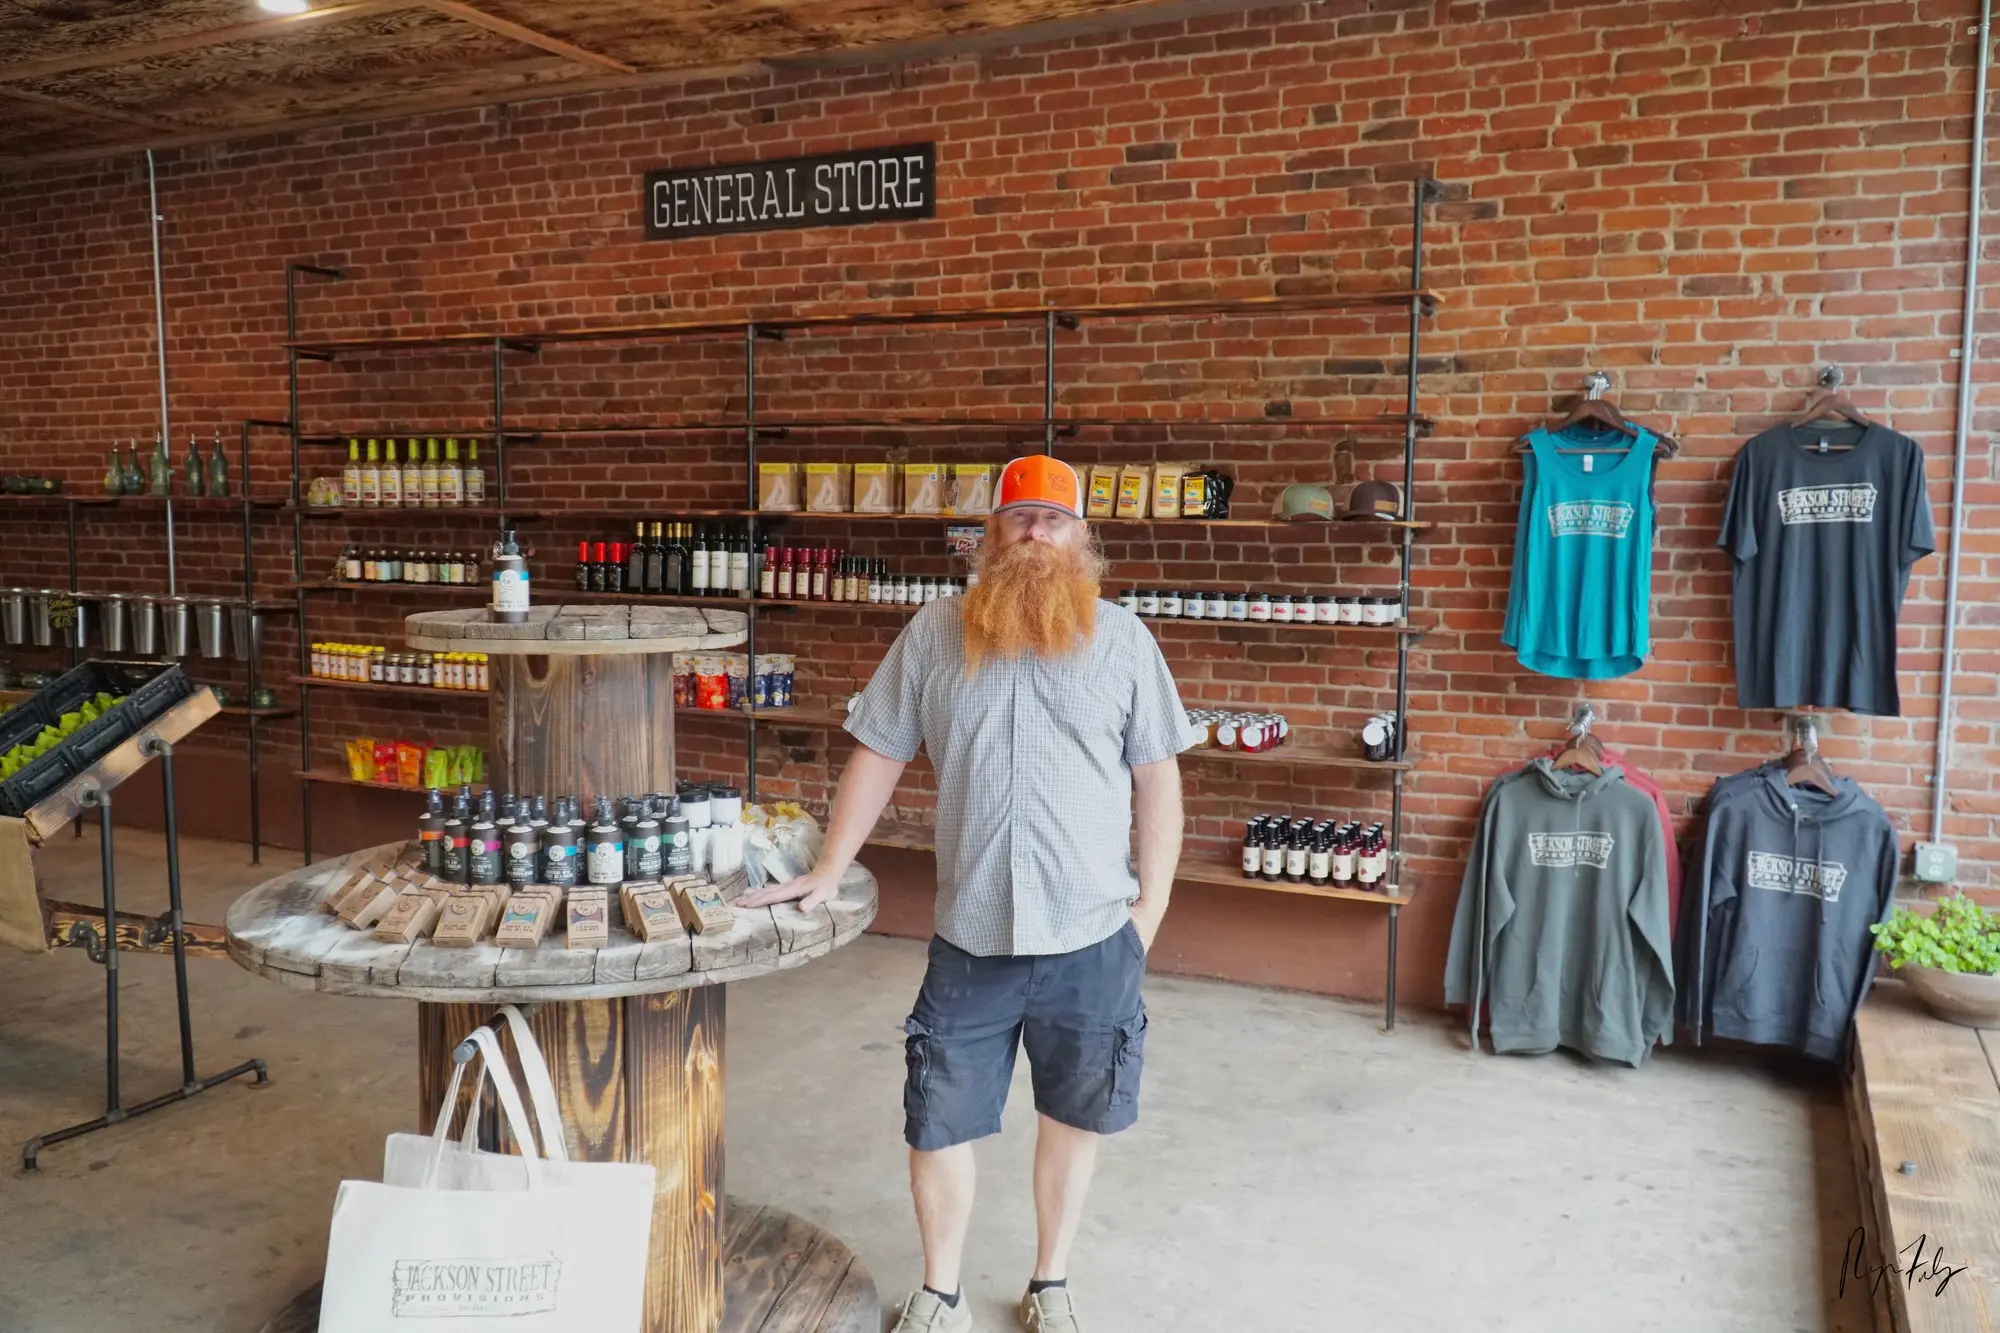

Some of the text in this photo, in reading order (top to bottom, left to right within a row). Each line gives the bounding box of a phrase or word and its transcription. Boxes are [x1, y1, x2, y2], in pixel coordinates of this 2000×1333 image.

[653, 155, 925, 229] GENERAL STORE
[1786, 489, 1872, 510] JACKSON STREET
[406, 1263, 552, 1292] JACKSON STREET
[405, 1293, 546, 1303] PROVISIONS
